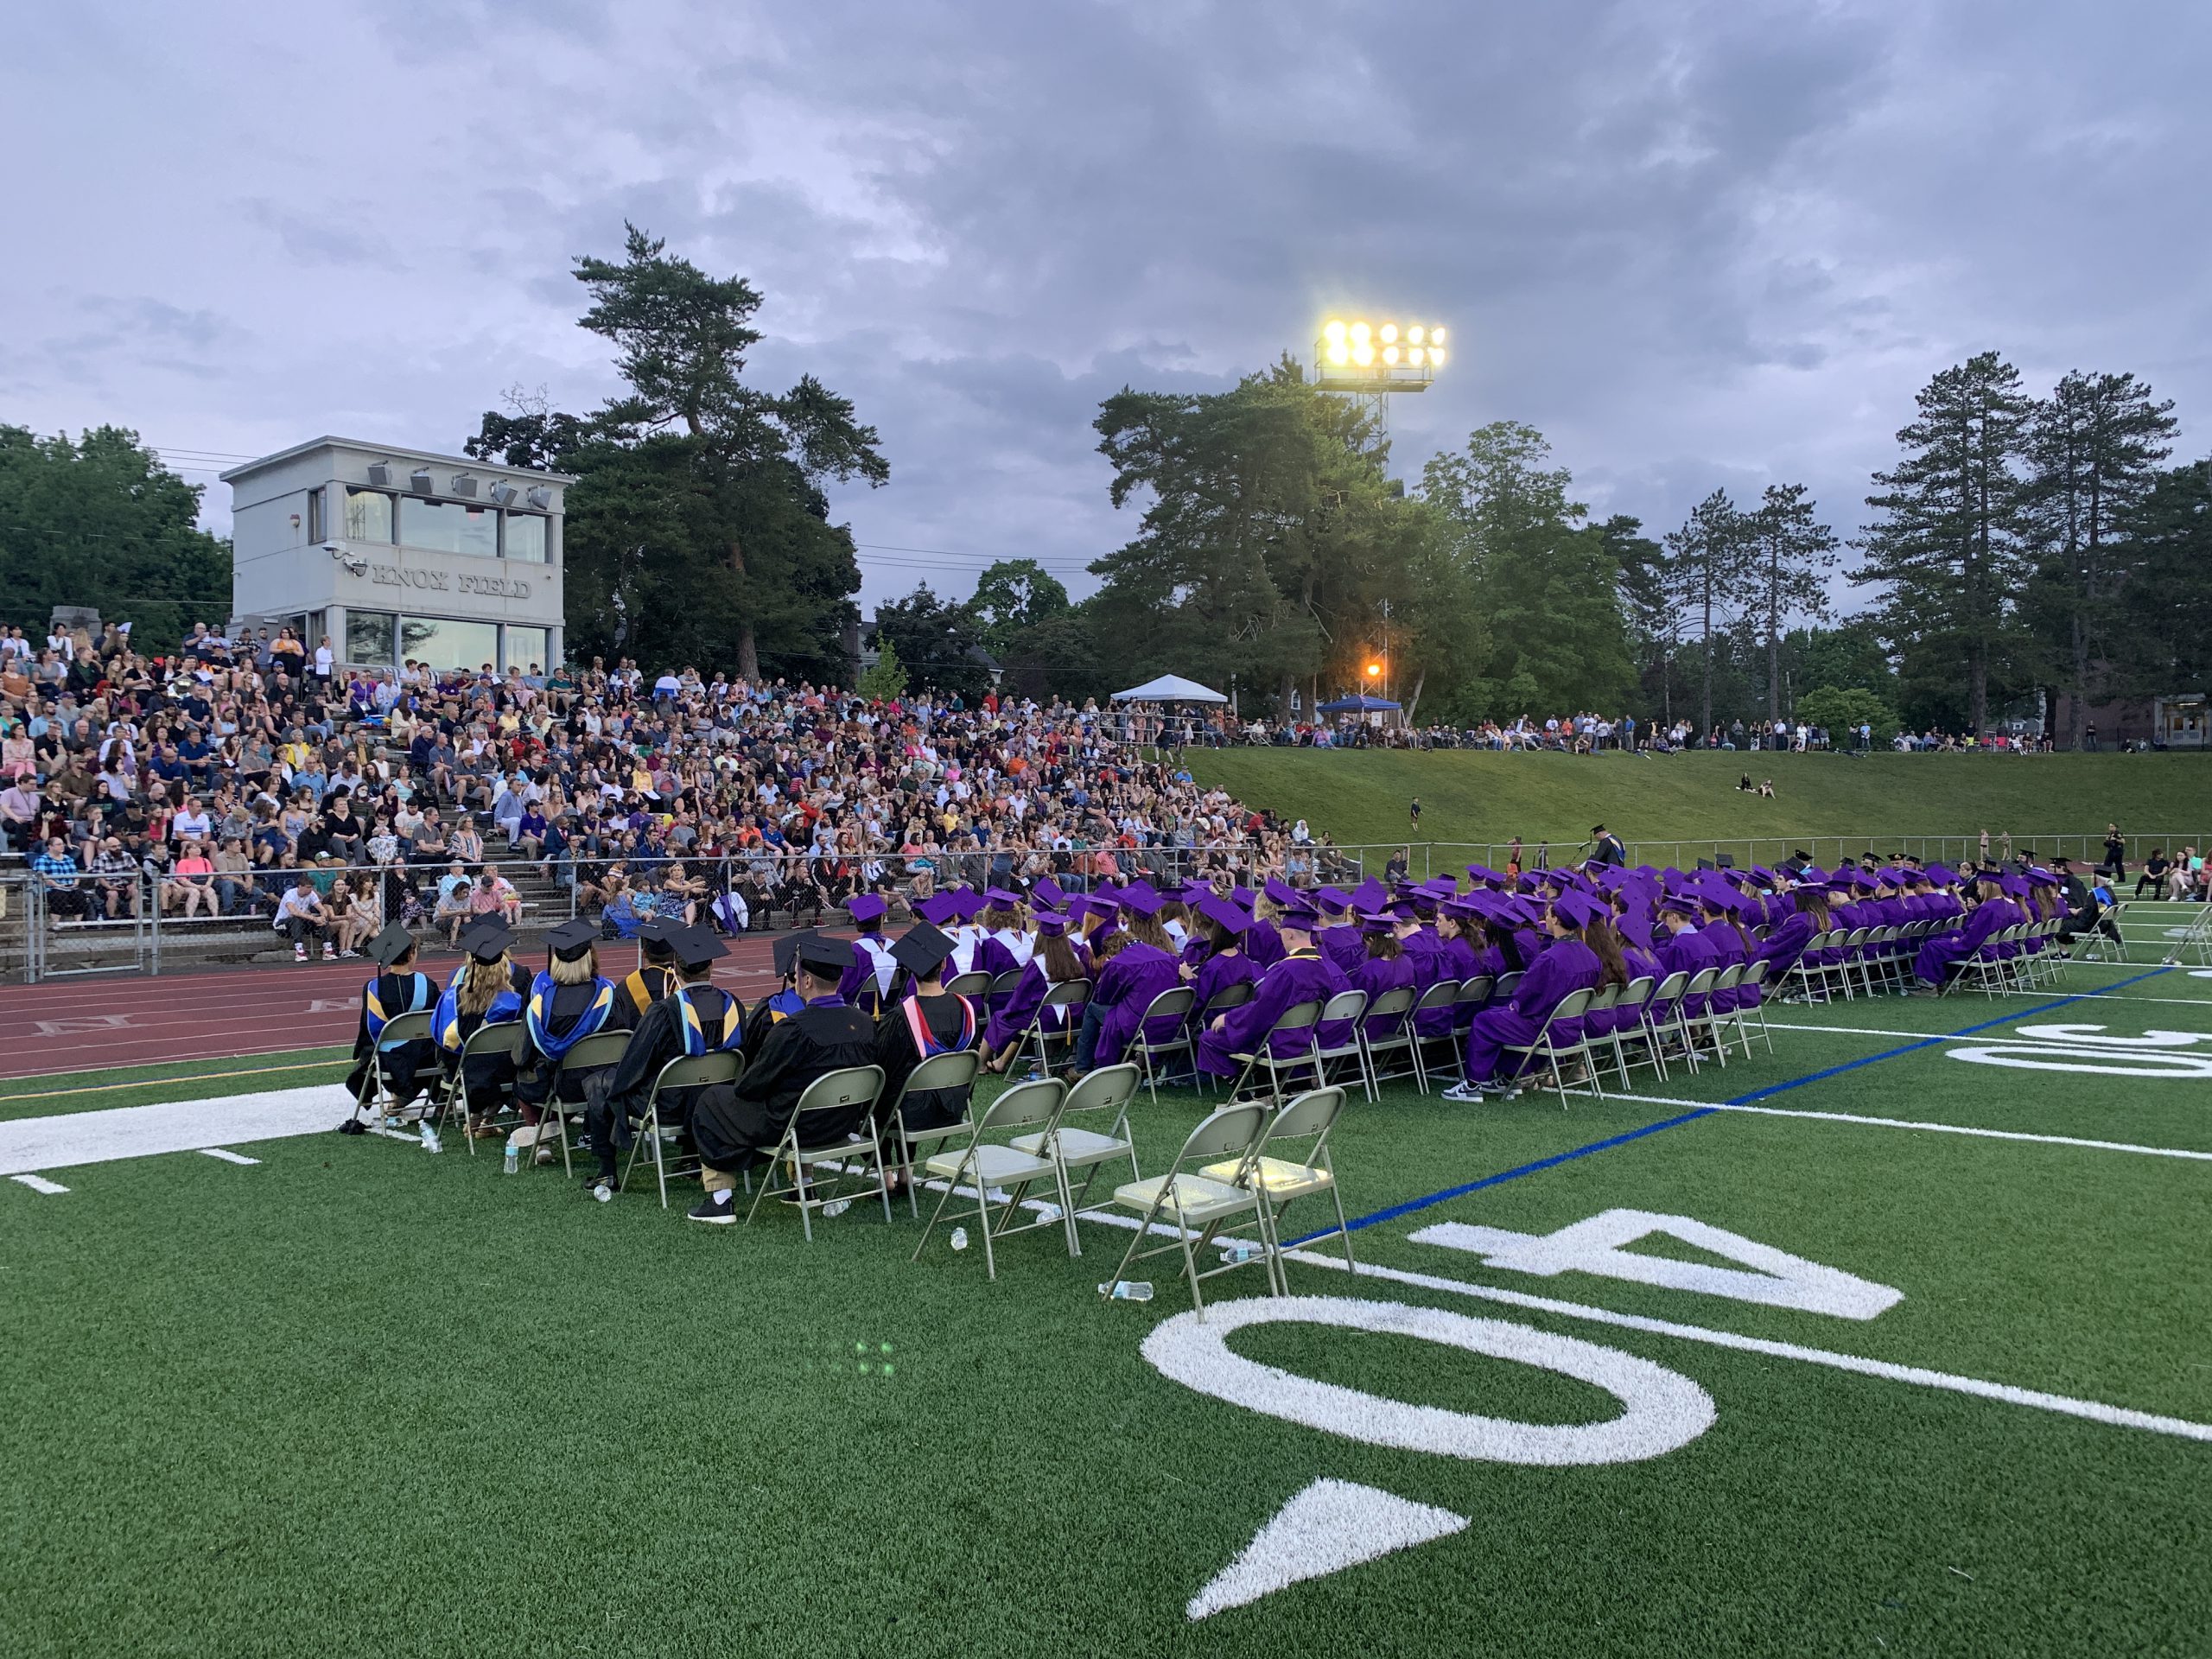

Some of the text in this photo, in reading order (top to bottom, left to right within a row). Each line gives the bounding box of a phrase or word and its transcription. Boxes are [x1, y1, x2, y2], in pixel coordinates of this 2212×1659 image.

[372, 564, 532, 599] KNOX FIELD
[1140, 1208, 1904, 1465] 40
